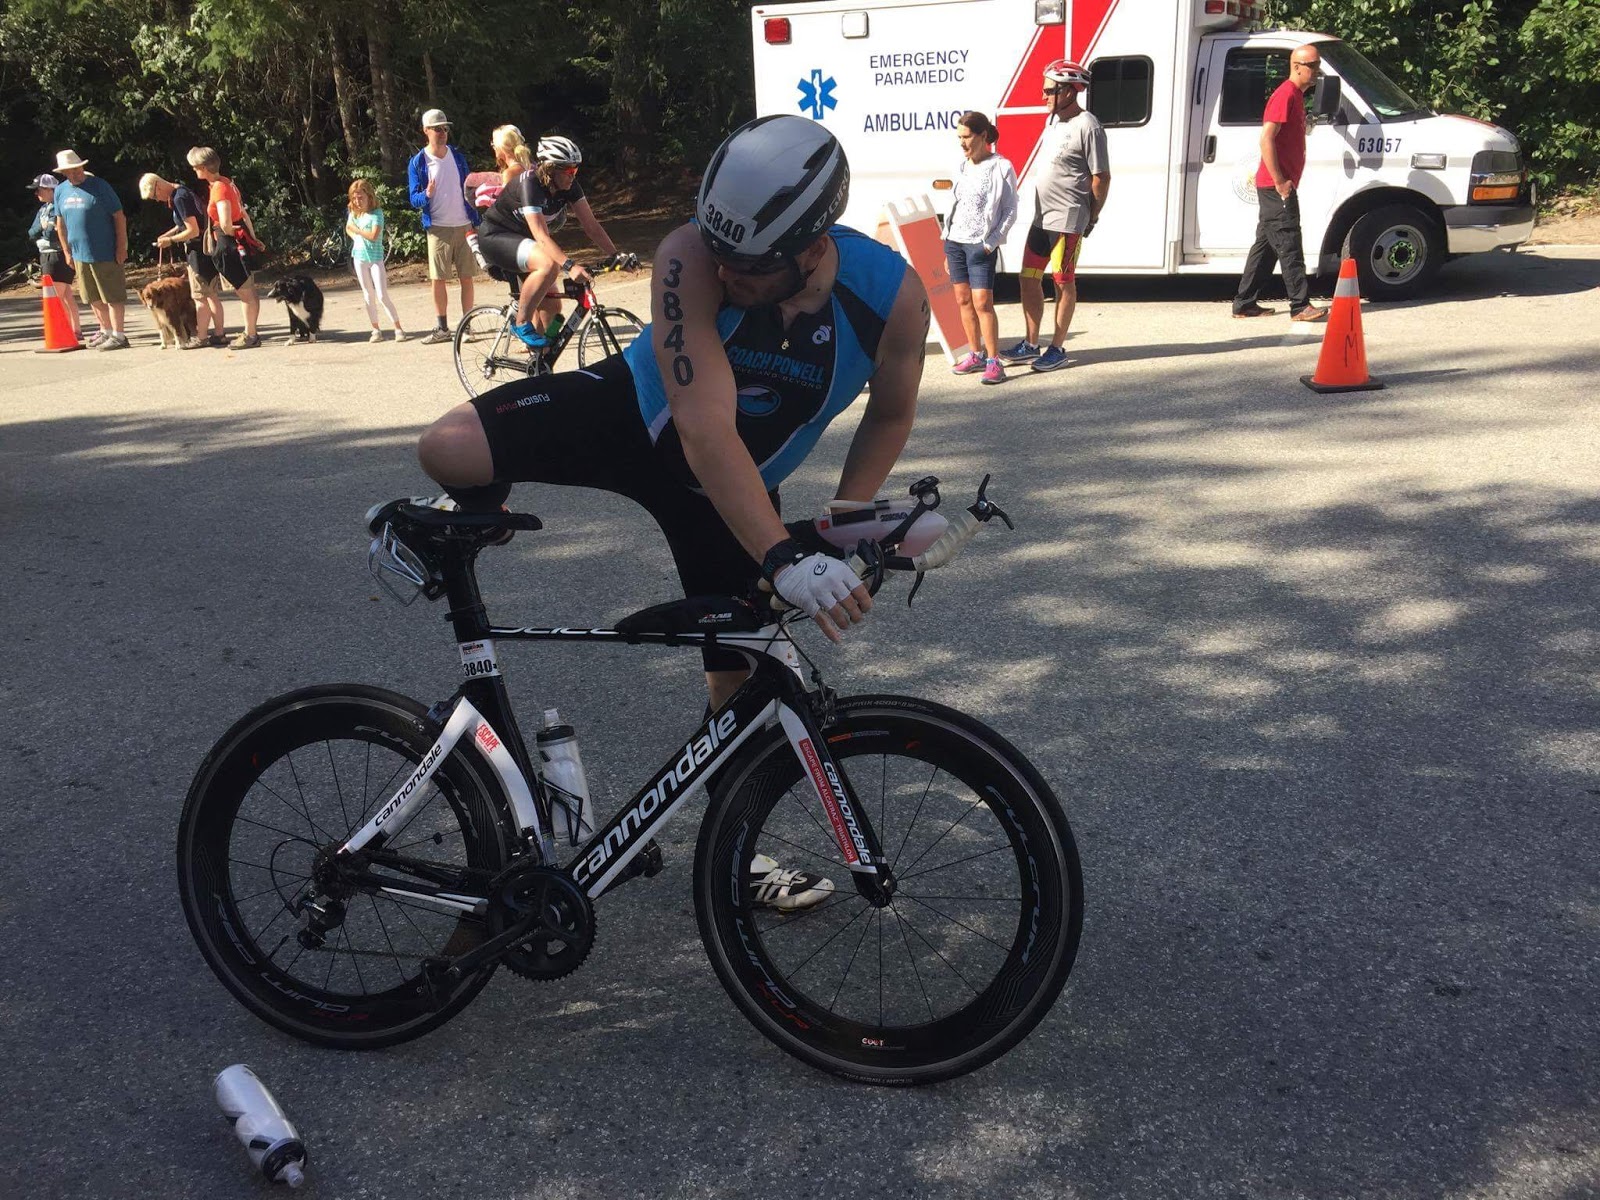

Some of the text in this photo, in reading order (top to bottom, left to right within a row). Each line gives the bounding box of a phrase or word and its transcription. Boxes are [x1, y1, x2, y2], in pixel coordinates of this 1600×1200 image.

[870, 49, 969, 69] EMERGENCY
[875, 68, 965, 86] PARAMEDIC
[1358, 137, 1402, 153] 63057
[706, 203, 746, 244] 3840
[663, 258, 694, 386] 3840
[772, 354, 824, 383] POWELL
[463, 659, 493, 677] 3840
[475, 723, 501, 752] ESCAPE
[375, 744, 443, 827] cannondale
[572, 709, 738, 887] cannondale
[813, 769, 825, 788] FROM
[836, 825, 855, 860] TRIATHLON
[824, 761, 871, 864] cannondale
